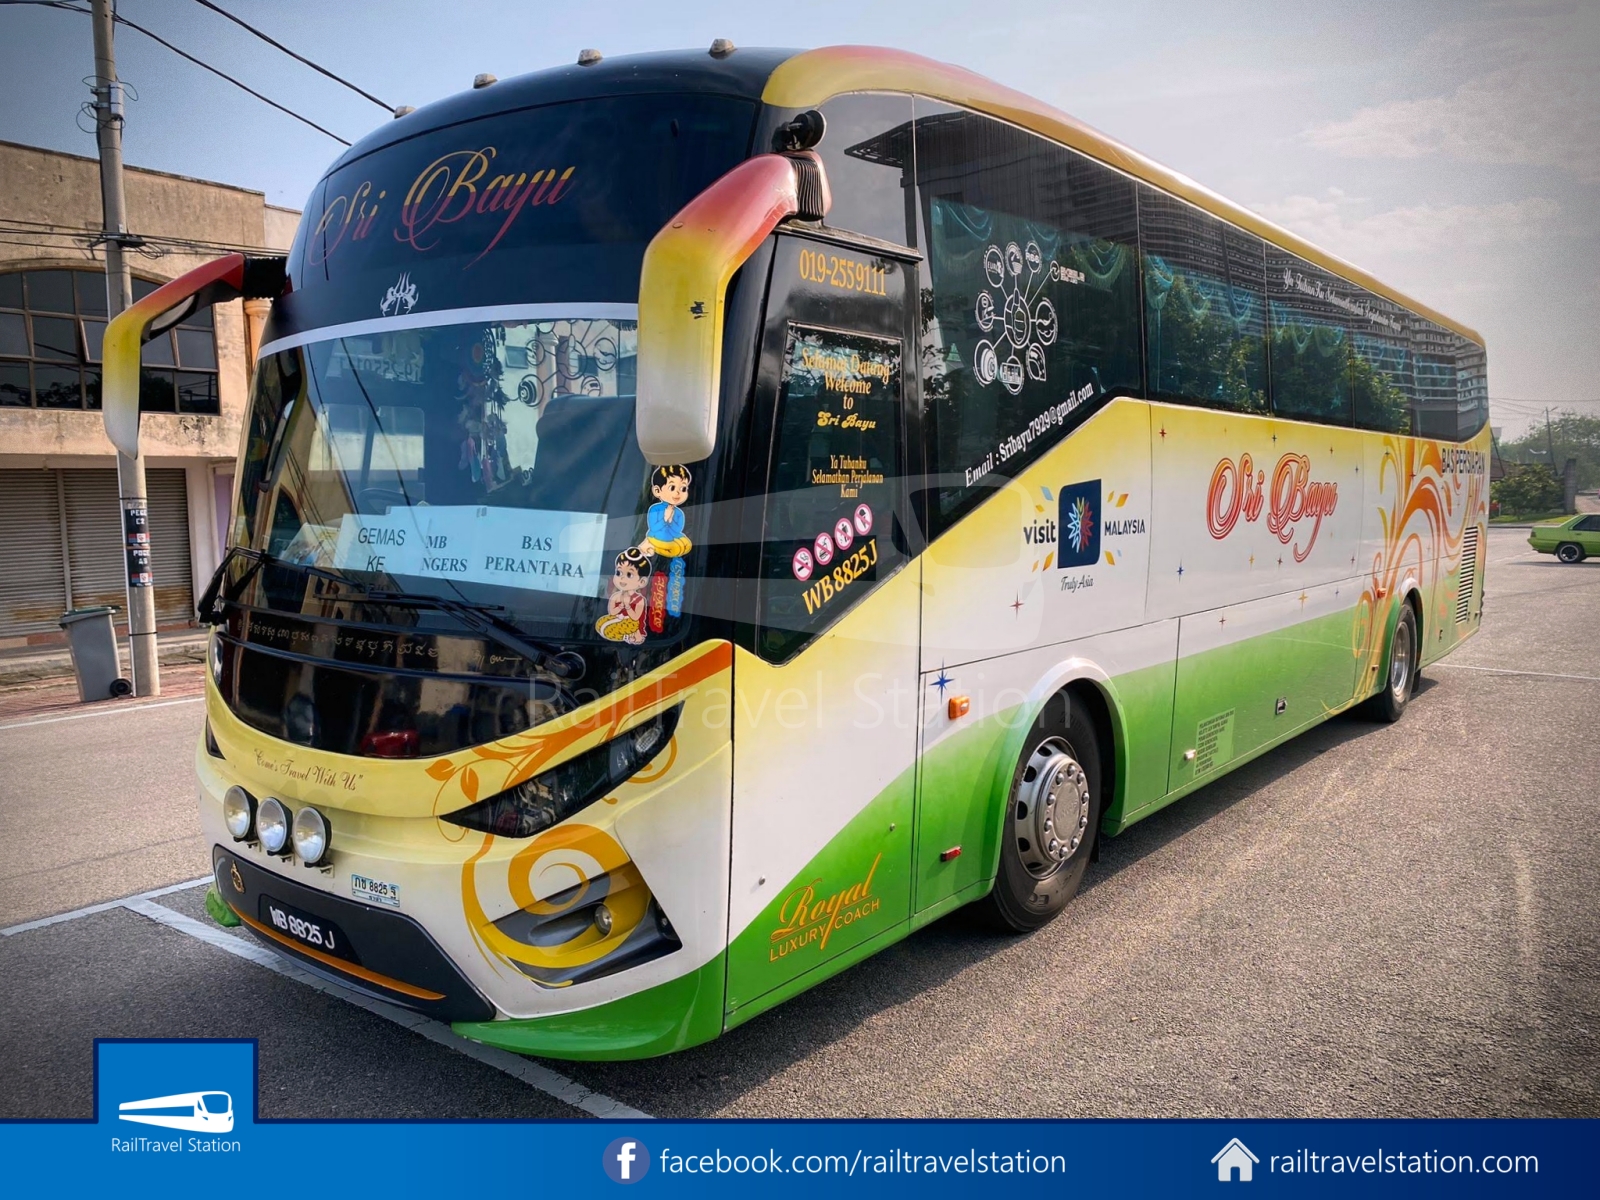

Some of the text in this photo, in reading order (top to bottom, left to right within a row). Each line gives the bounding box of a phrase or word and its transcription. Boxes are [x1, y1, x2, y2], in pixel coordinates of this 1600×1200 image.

[308, 146, 576, 270] Sri Bayu
[800, 249, 887, 296] 019-2559111
[850, 354, 891, 385] Datang
[825, 371, 872, 394] Welcome
[843, 394, 854, 410] to
[817, 410, 876, 431] Sri Bayu
[965, 452, 994, 488] Email
[999, 382, 1094, 462] Sribayu7929@gmail.com
[830, 455, 867, 469] Ya Tuhanku
[812, 469, 884, 488] Selamatkan Perjalanan
[840, 484, 858, 498] Kami
[1206, 452, 1338, 563] Sri Bayu
[358, 527, 406, 546] GEMAS
[1023, 518, 1145, 545] visit MALAYSIA
[521, 536, 552, 551] BAS
[421, 557, 467, 572] NGERS
[484, 556, 584, 578] PERANTARA
[1060, 574, 1093, 593] Truly Asia
[280, 758, 311, 781] Travel
[312, 765, 336, 788] With
[369, 881, 388, 895] 8825
[770, 852, 882, 950] Royal
[288, 915, 322, 945] 8825
[325, 931, 335, 949] J
[769, 898, 880, 963] LUXURY COACH
